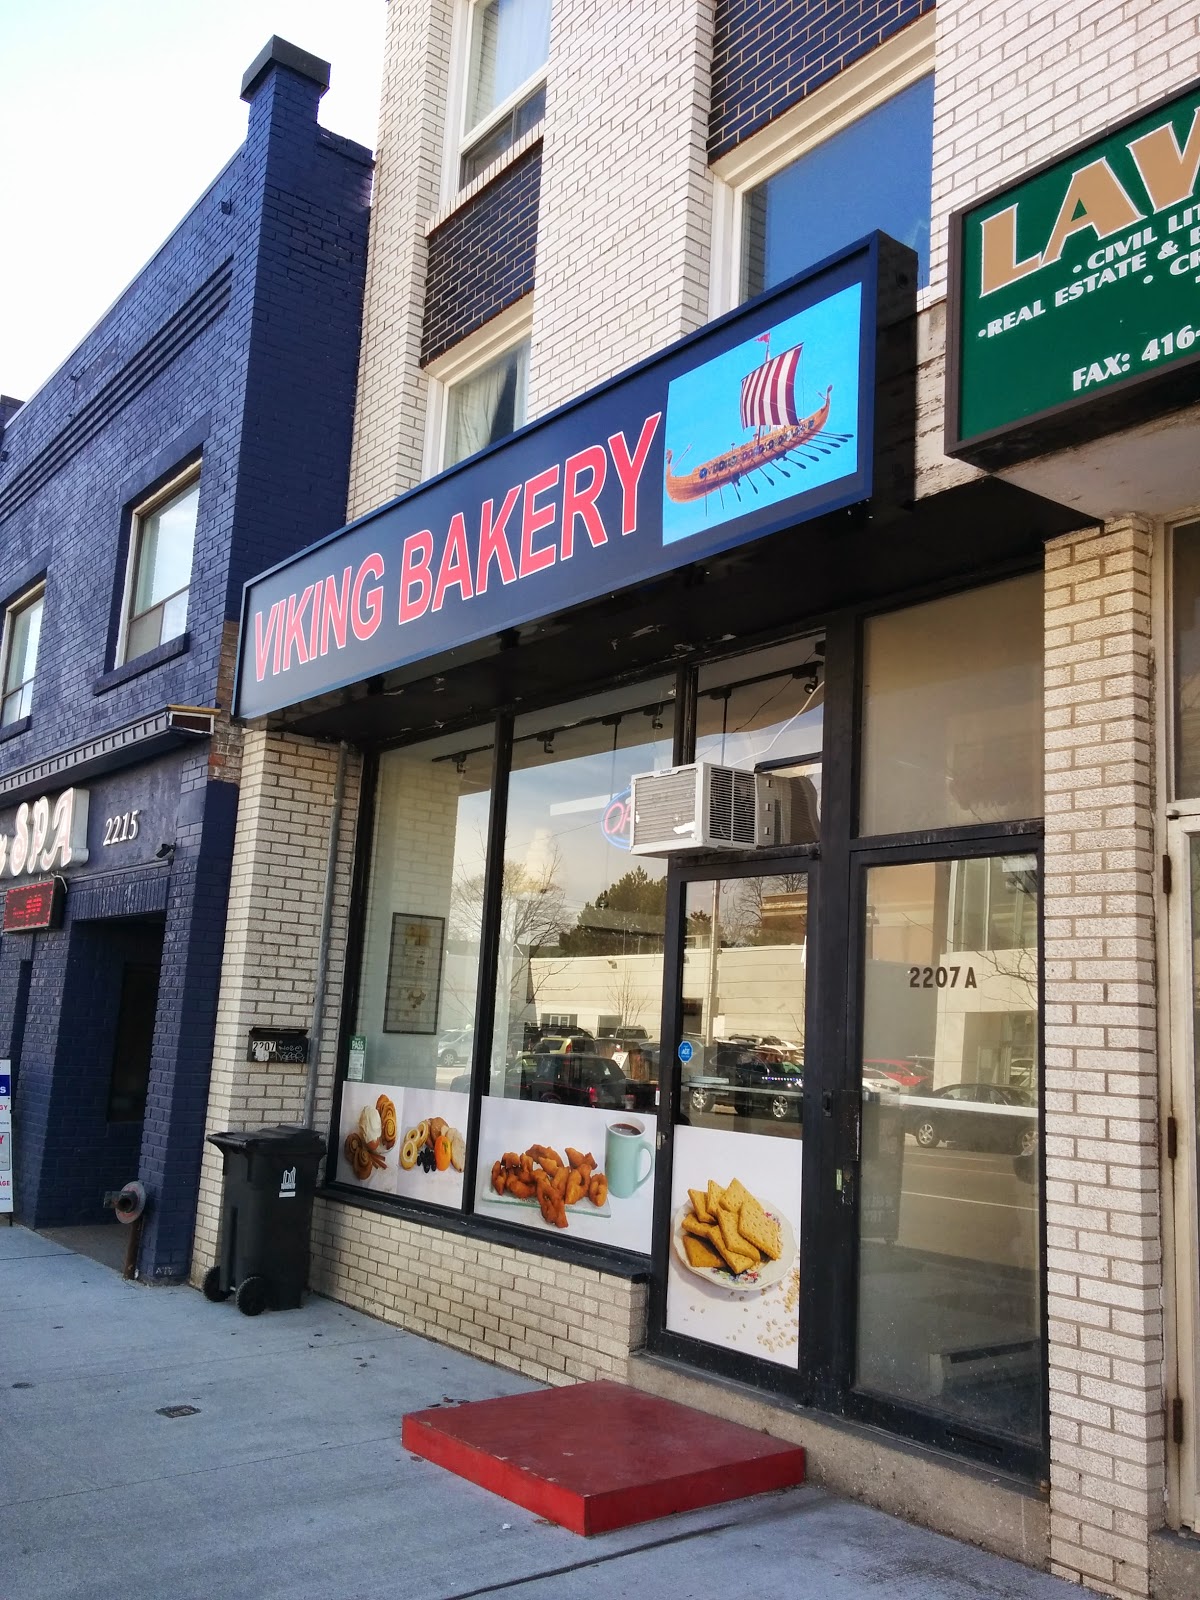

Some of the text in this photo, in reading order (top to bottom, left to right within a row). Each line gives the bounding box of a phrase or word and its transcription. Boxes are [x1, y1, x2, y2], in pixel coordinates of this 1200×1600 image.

[1087, 227, 1157, 275] CIVIL
[987, 240, 1178, 338] REAL ESTATE &
[1073, 353, 1130, 391] FAX:
[254, 411, 662, 682] VIKING BAKERY
[10, 787, 74, 876] SPA
[103, 809, 140, 846] 2215
[253, 1041, 276, 1051] 2207
[351, 1040, 364, 1050] PASS
